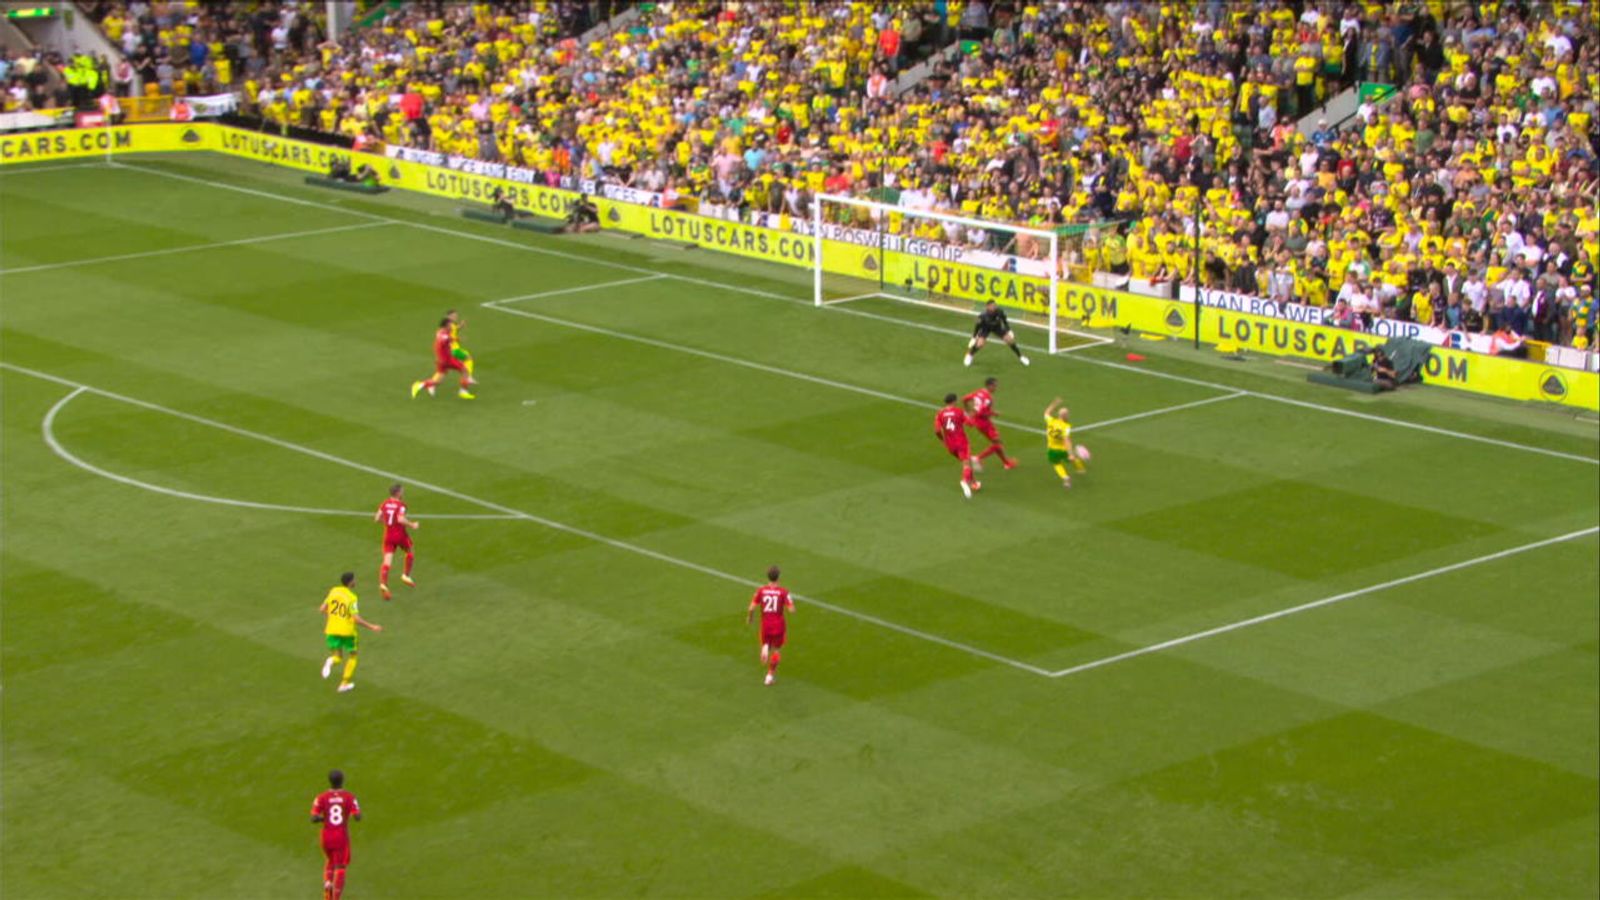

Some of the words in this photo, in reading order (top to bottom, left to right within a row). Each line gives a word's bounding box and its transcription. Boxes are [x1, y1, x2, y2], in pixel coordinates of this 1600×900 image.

[2, 130, 131, 158] CARS.COM
[908, 239, 963, 263] GROUP
[914, 259, 1118, 319] LOTUSCARS.COM
[946, 417, 955, 431] 4
[386, 509, 395, 526] 7
[331, 599, 347, 618] 20
[763, 595, 778, 612] 21
[329, 804, 343, 826] 8
